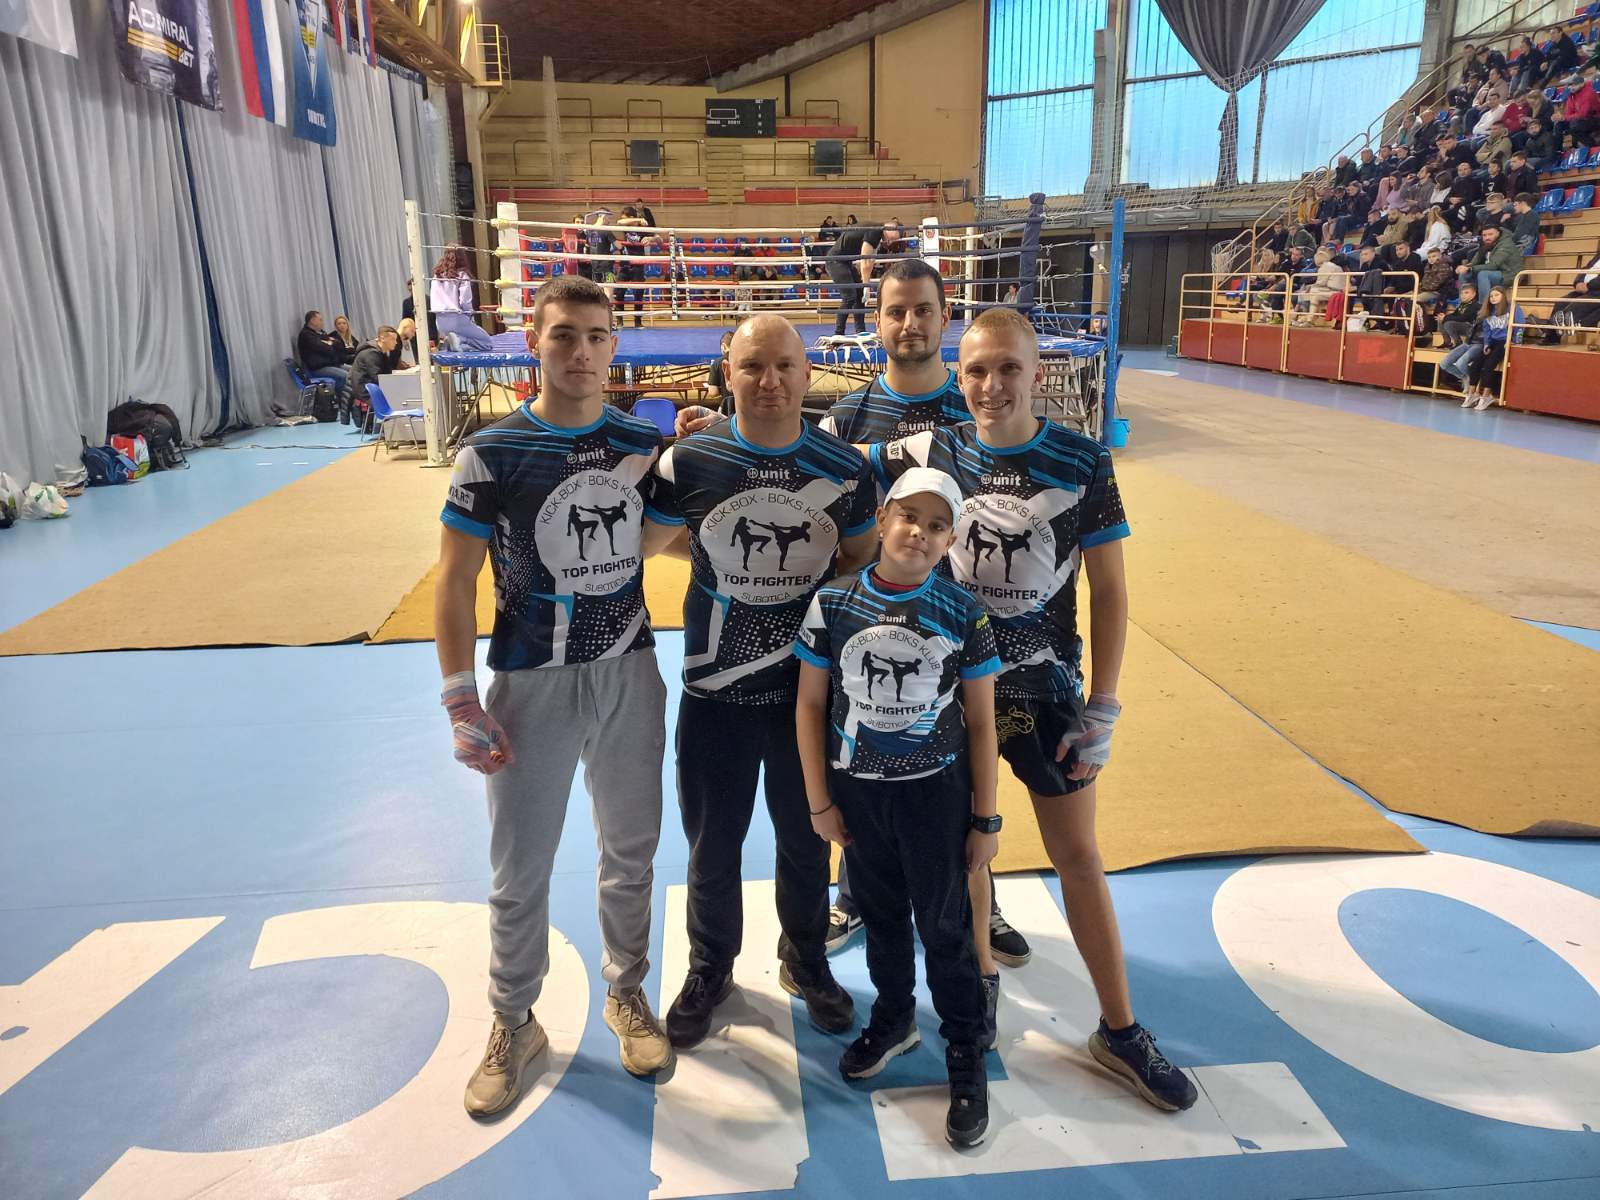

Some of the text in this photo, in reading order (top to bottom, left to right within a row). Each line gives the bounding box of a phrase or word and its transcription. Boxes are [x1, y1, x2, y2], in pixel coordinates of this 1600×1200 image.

[128, 1, 194, 52] ADMIRAL
[178, 50, 194, 68] BET
[908, 421, 934, 431] unit
[578, 448, 607, 462] unit
[760, 468, 790, 480] unit
[993, 474, 1021, 487] unit
[540, 481, 584, 525] KICK-BOX
[588, 475, 619, 489] BOKS
[620, 484, 643, 512] KLUB
[705, 493, 758, 532] KICK-BOX
[767, 493, 804, 511] BOKS
[805, 507, 834, 535] KLUB
[997, 499, 1030, 518] BOKS
[1028, 514, 1053, 544] KLUB
[561, 556, 638, 580] TOP FIGHTER
[584, 576, 630, 593] SUBOTICA
[724, 574, 812, 587] TOP FIGHTER
[741, 592, 792, 604] SUBOTICA
[982, 586, 1038, 600] FIGHTER
[885, 615, 907, 624] unit
[842, 630, 881, 661] KICK-BOX
[889, 630, 920, 648] BOKS
[919, 645, 941, 671] KLUB
[855, 701, 928, 716] TOP FIGHTER
